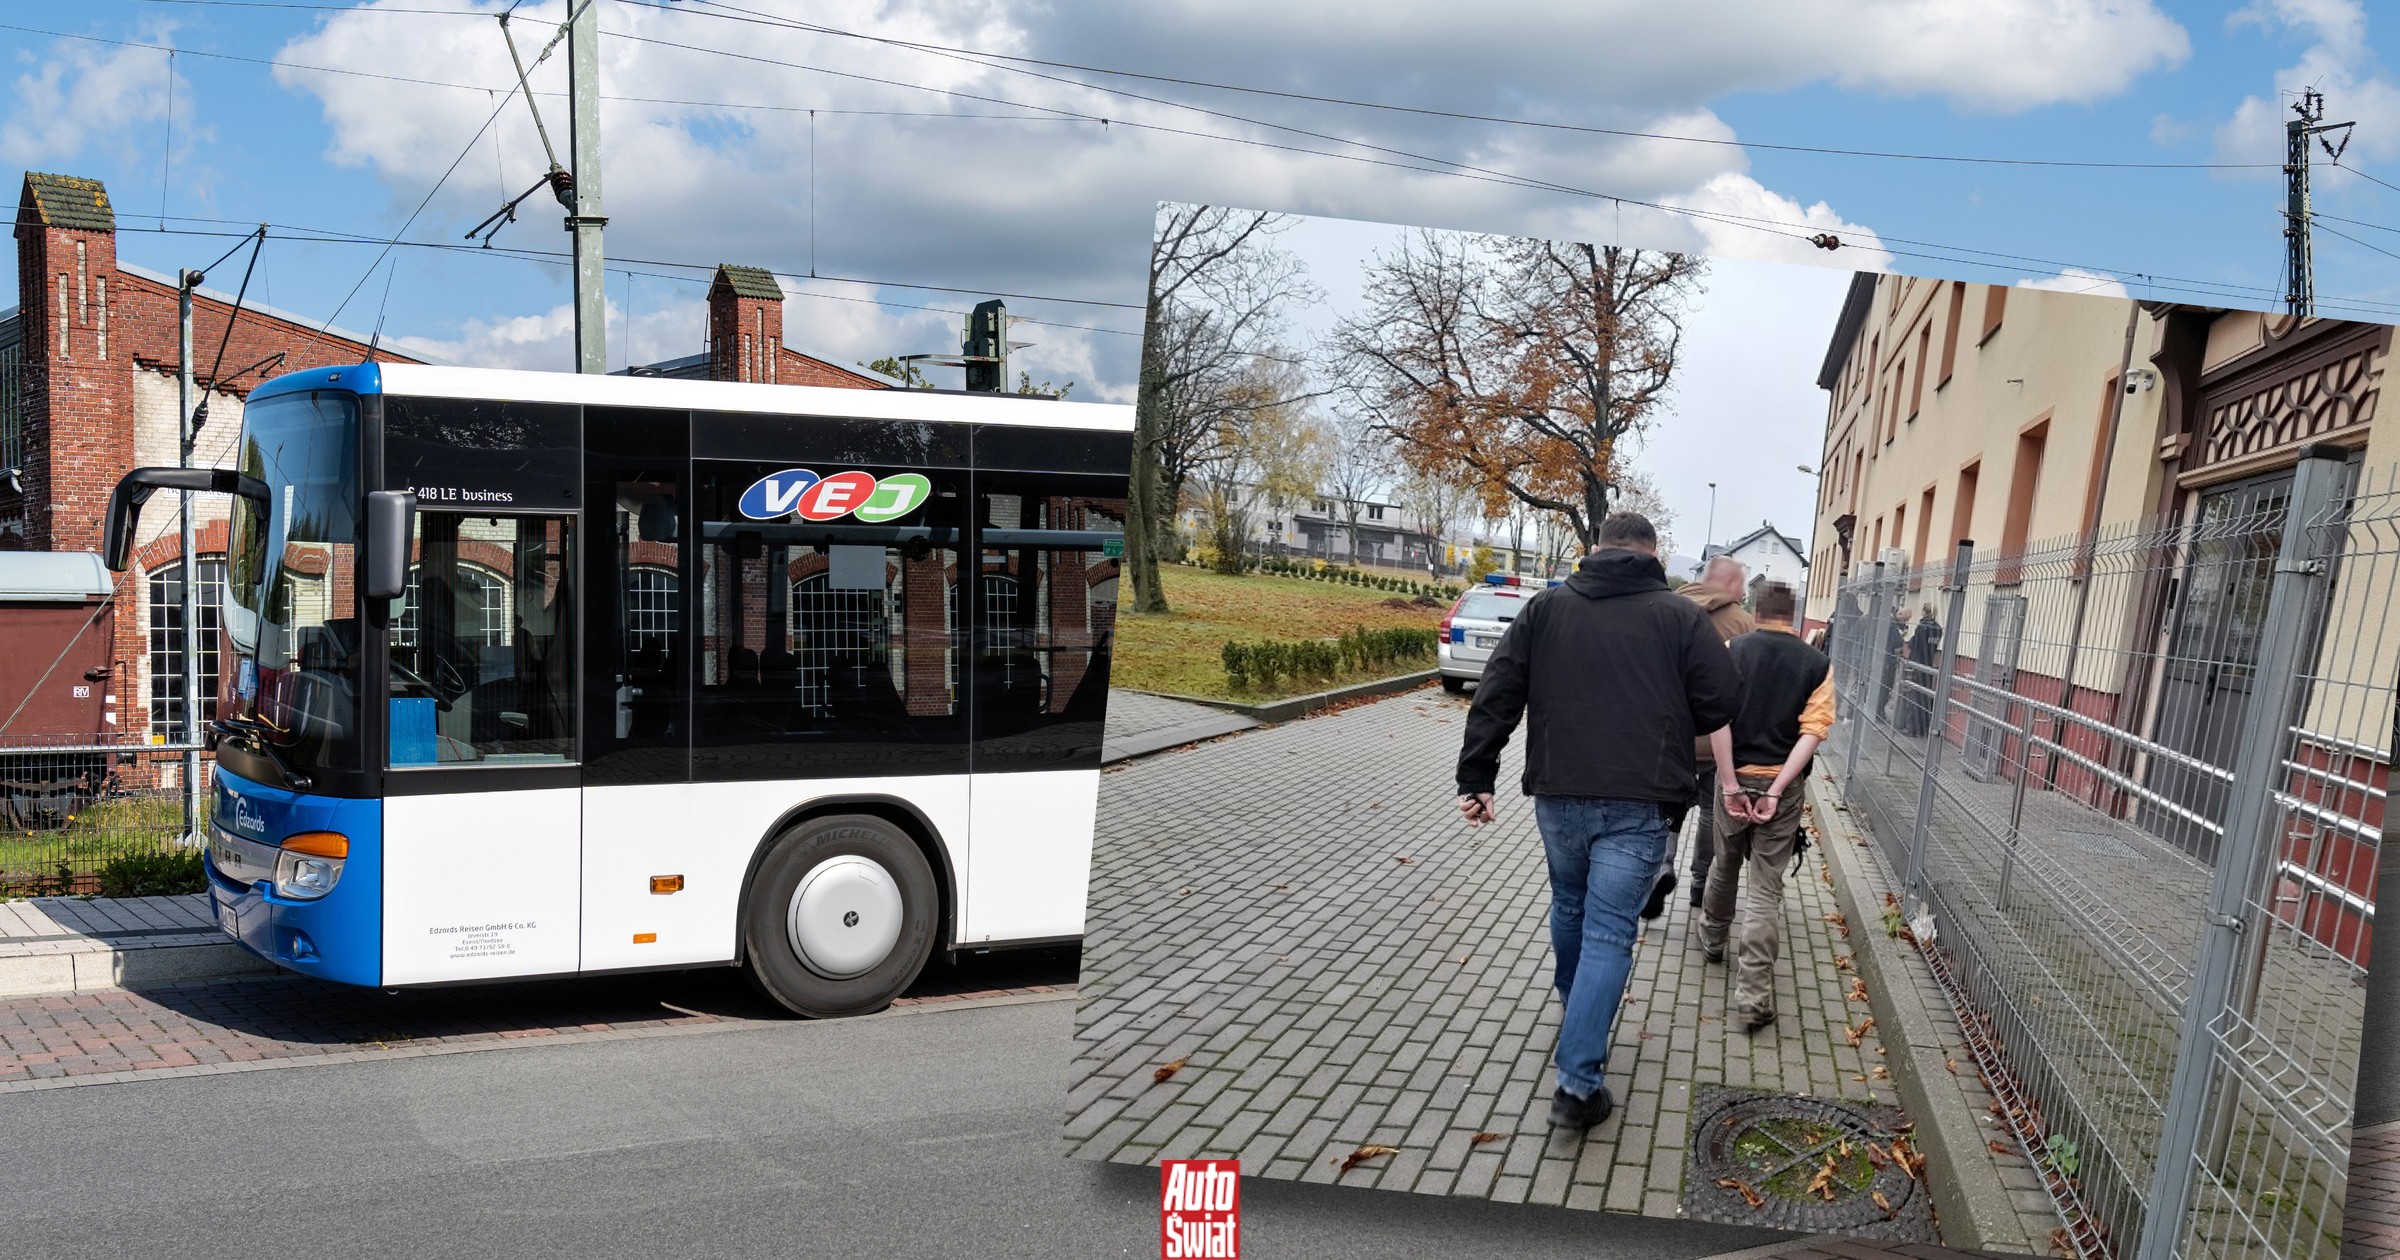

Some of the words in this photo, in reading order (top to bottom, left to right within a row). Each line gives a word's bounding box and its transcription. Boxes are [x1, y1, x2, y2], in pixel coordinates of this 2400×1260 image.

[418, 487, 438, 500] 418
[440, 488, 457, 500] LE
[462, 489, 513, 502] business
[766, 480, 916, 514] VEJ
[239, 808, 265, 833] Edzards
[429, 926, 458, 934] Edzards
[459, 925, 484, 933] Reisen
[485, 922, 507, 932] GmbH
[508, 922, 513, 930] &
[514, 922, 526, 930] Co.
[527, 921, 537, 929] KG
